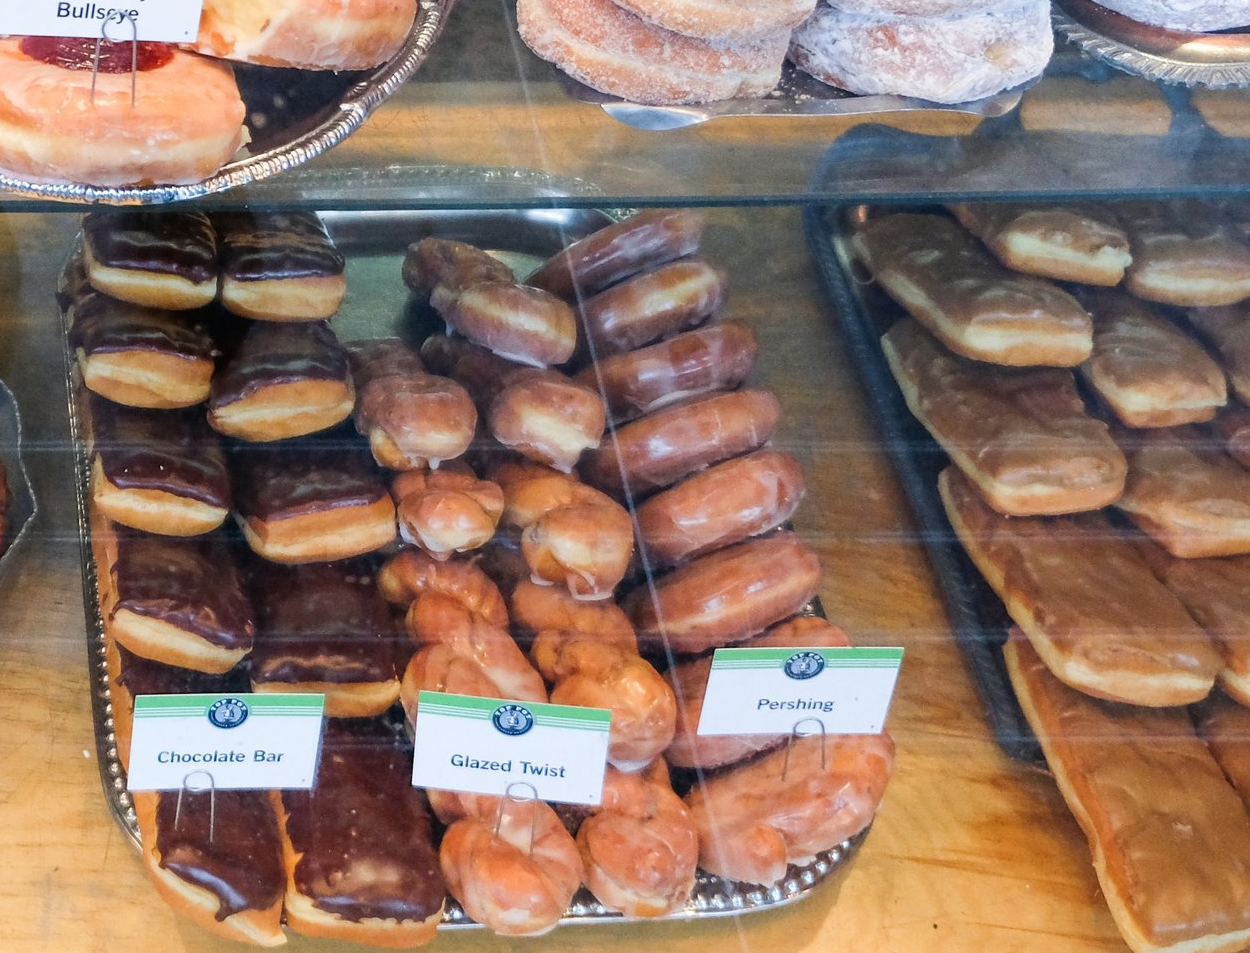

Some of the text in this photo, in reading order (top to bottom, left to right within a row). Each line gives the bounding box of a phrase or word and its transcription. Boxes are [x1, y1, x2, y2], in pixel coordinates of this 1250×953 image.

[56, 2, 139, 24] Bullseye
[757, 697, 835, 713] Pershing
[157, 749, 284, 763] Chocolate Bar
[450, 754, 567, 778] Glazed Twist
